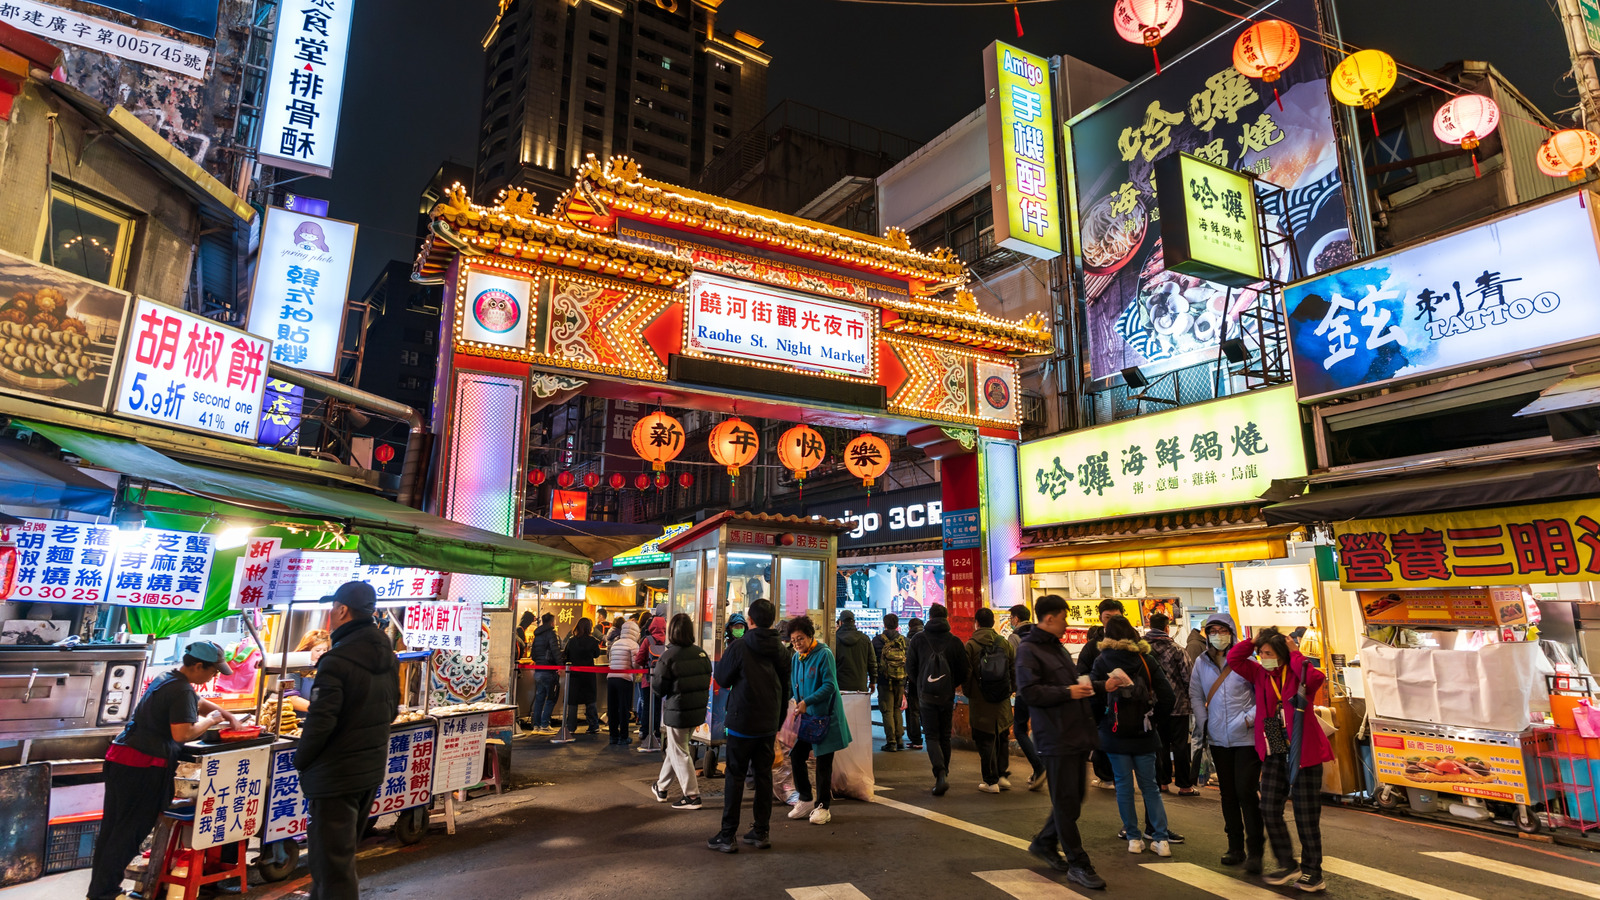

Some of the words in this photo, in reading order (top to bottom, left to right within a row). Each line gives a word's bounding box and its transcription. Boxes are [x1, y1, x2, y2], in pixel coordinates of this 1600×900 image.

[1003, 50, 1043, 86] Amigo
[1011, 84, 1050, 237] 手機配件
[1110, 113, 1285, 218] 海鍋燒
[1199, 217, 1244, 243] 海鮮鍋燒
[281, 248, 309, 260] spring
[308, 253, 335, 263] photo
[273, 264, 321, 364] 韓式拍貼機
[699, 289, 866, 342] 饒河街觀光夜市
[1415, 270, 1522, 322] 刺青
[1424, 291, 1561, 340] TATTOO
[135, 309, 264, 394] 胡椒餅
[696, 323, 742, 345] Raohe
[749, 330, 768, 350] St.
[776, 337, 813, 360] Night
[819, 345, 867, 365] Market
[129, 372, 186, 420] 5.9折
[193, 390, 230, 410] second
[235, 401, 252, 414] one
[199, 411, 225, 430] 41%
[234, 420, 250, 435] off
[650, 423, 683, 451] 新
[729, 426, 757, 454] 年
[796, 432, 824, 460] 快
[850, 441, 882, 467] 樂
[730, 530, 775, 546] 媽祖廟口
[797, 535, 829, 549] 服務台
[811, 510, 878, 538] igo
[41, 525, 80, 585] 老麵燒
[75, 527, 112, 587] 蘿蔔絲
[146, 533, 182, 591] 芝麻燒
[176, 535, 210, 593] 蟹殼黃
[240, 540, 274, 607] 胡椒餅
[15, 585, 33, 596] 0
[38, 586, 66, 598] 30
[72, 588, 99, 600] 25
[410, 578, 444, 596] 免費
[1240, 587, 1309, 608] 慢慢煮茶
[405, 632, 462, 647] 不好吃免費
[407, 605, 450, 631] 胡椒餅
[558, 607, 574, 624] 餅
[413, 730, 433, 742] 招牌
[271, 752, 299, 822] 蟹殼黃
[385, 734, 410, 796] 蘿蔔絲
[410, 741, 432, 791] 胡椒餅
[199, 759, 220, 834] 客人虐我
[212, 786, 230, 844] 千萬遍
[230, 759, 250, 832] 我待客人
[243, 779, 261, 837] 如初戀
[383, 795, 405, 812] 25
[410, 790, 429, 804] 70
